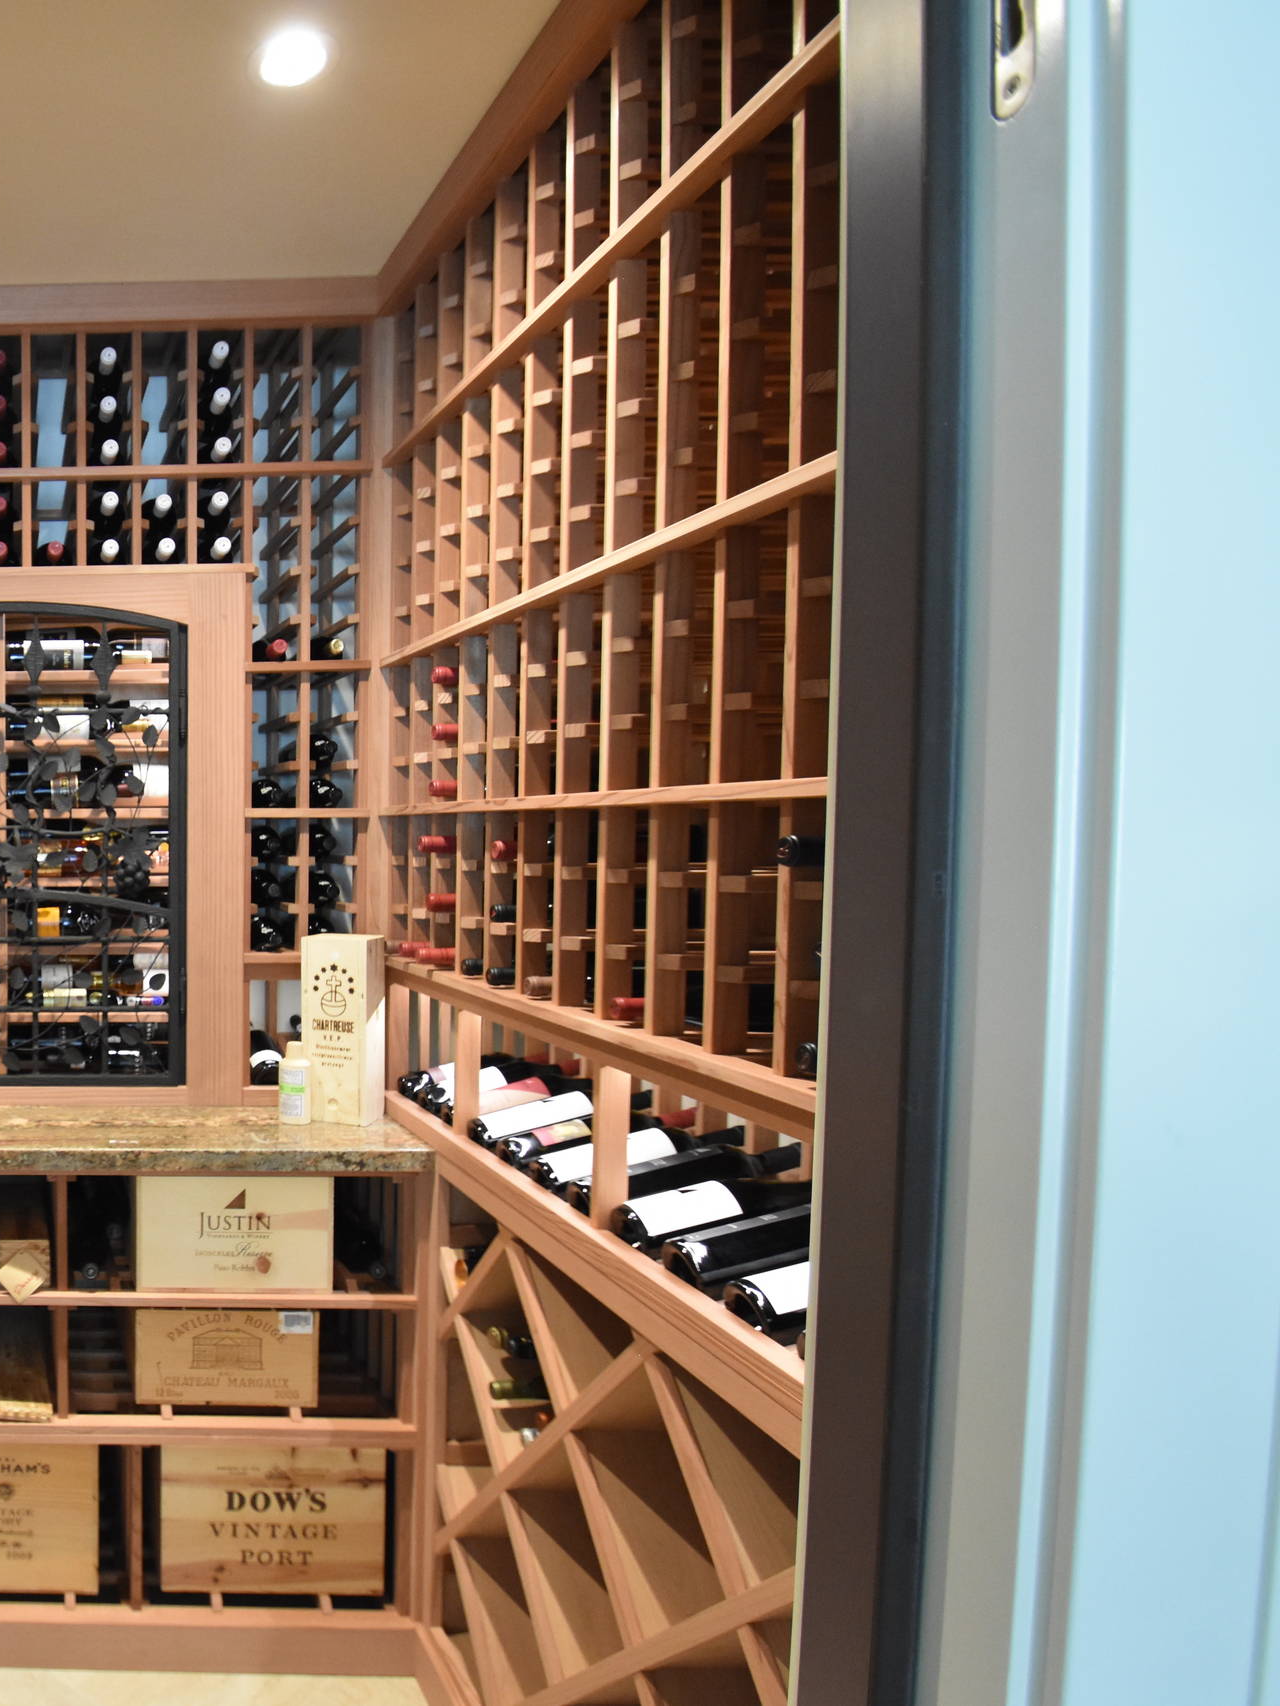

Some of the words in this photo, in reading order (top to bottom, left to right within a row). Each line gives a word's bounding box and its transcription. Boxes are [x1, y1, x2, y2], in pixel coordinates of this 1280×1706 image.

[312, 1019, 354, 1034] CHARTREUSE
[199, 1212, 271, 1239] JUSTIN
[167, 1312, 232, 1343] PAVILLON
[244, 1314, 289, 1345] ROUGE
[228, 1377, 289, 1389] MARGAUX
[225, 1488, 328, 1513] DOW'S
[209, 1522, 338, 1540] VINTAGE
[240, 1549, 313, 1566] PORT
